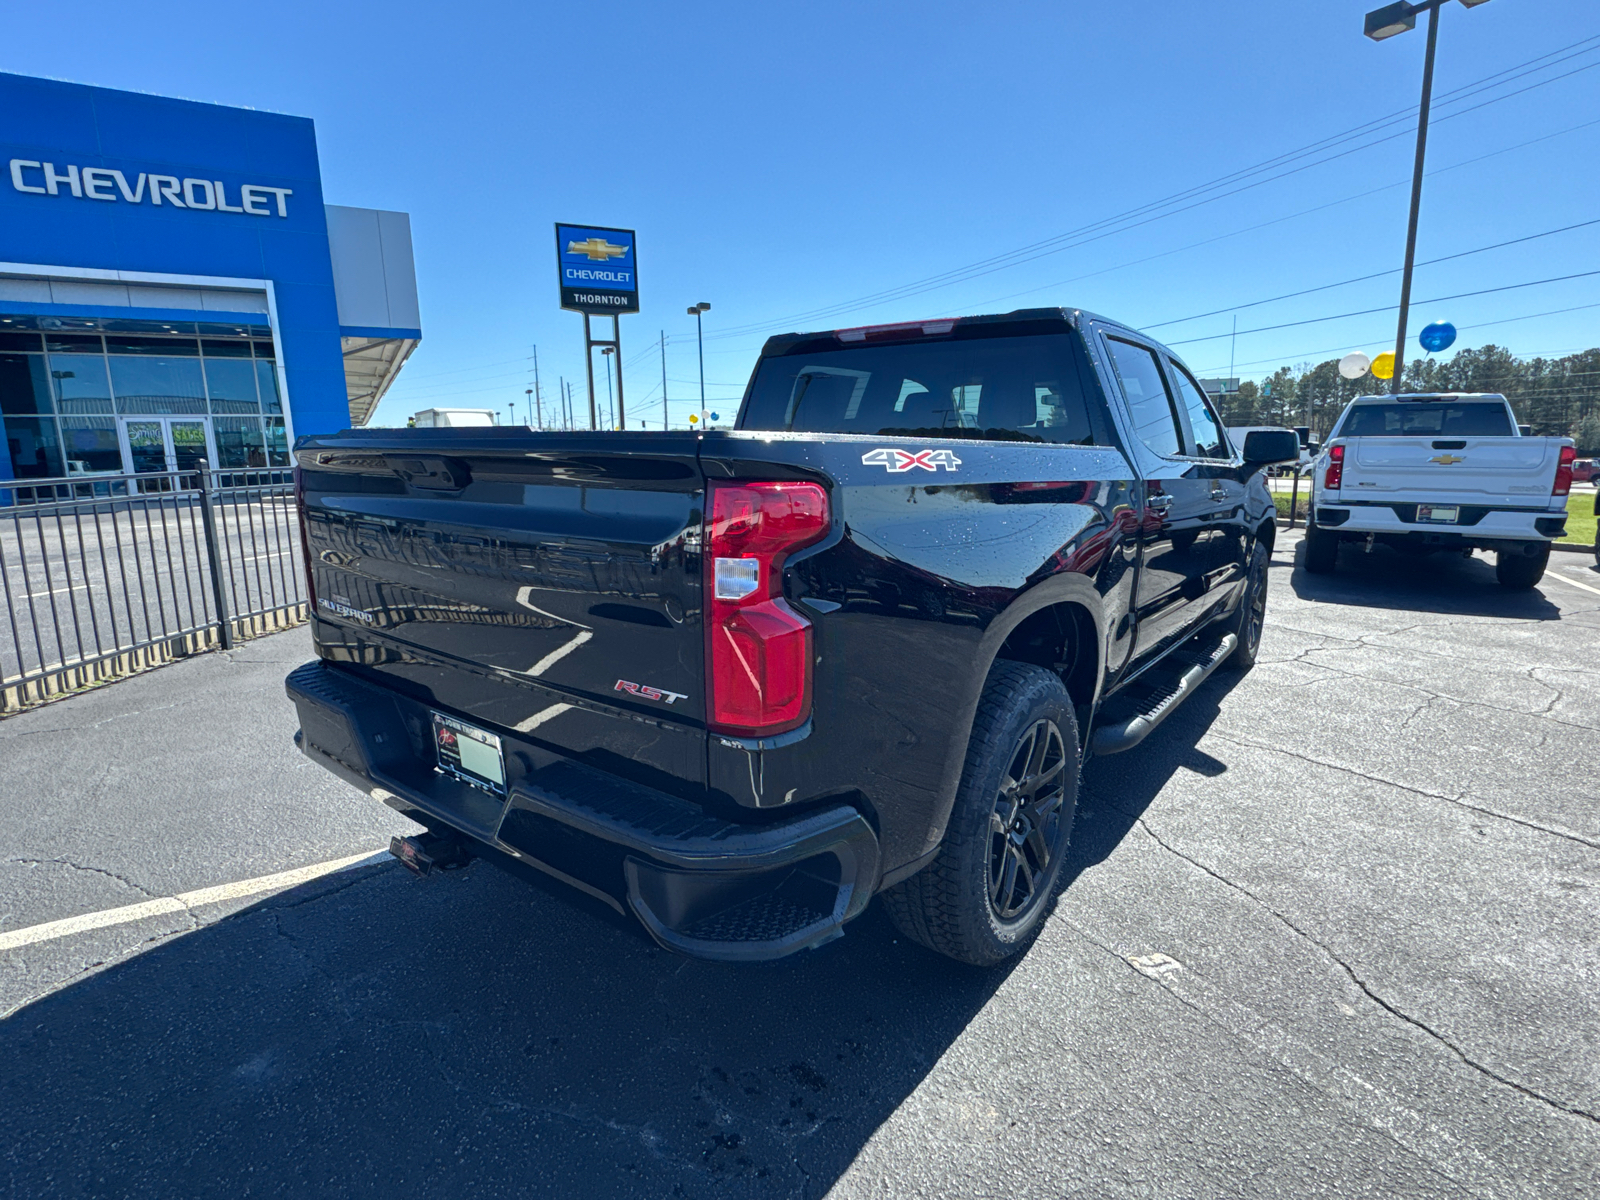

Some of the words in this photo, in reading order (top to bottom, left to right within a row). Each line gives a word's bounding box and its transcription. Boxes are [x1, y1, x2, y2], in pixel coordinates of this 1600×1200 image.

[10, 158, 293, 217] CHEVROLET
[566, 268, 631, 282] CHEVROLET
[573, 293, 628, 305] THORNTON
[317, 597, 374, 623] SILVERADO
[614, 679, 689, 705] RST
